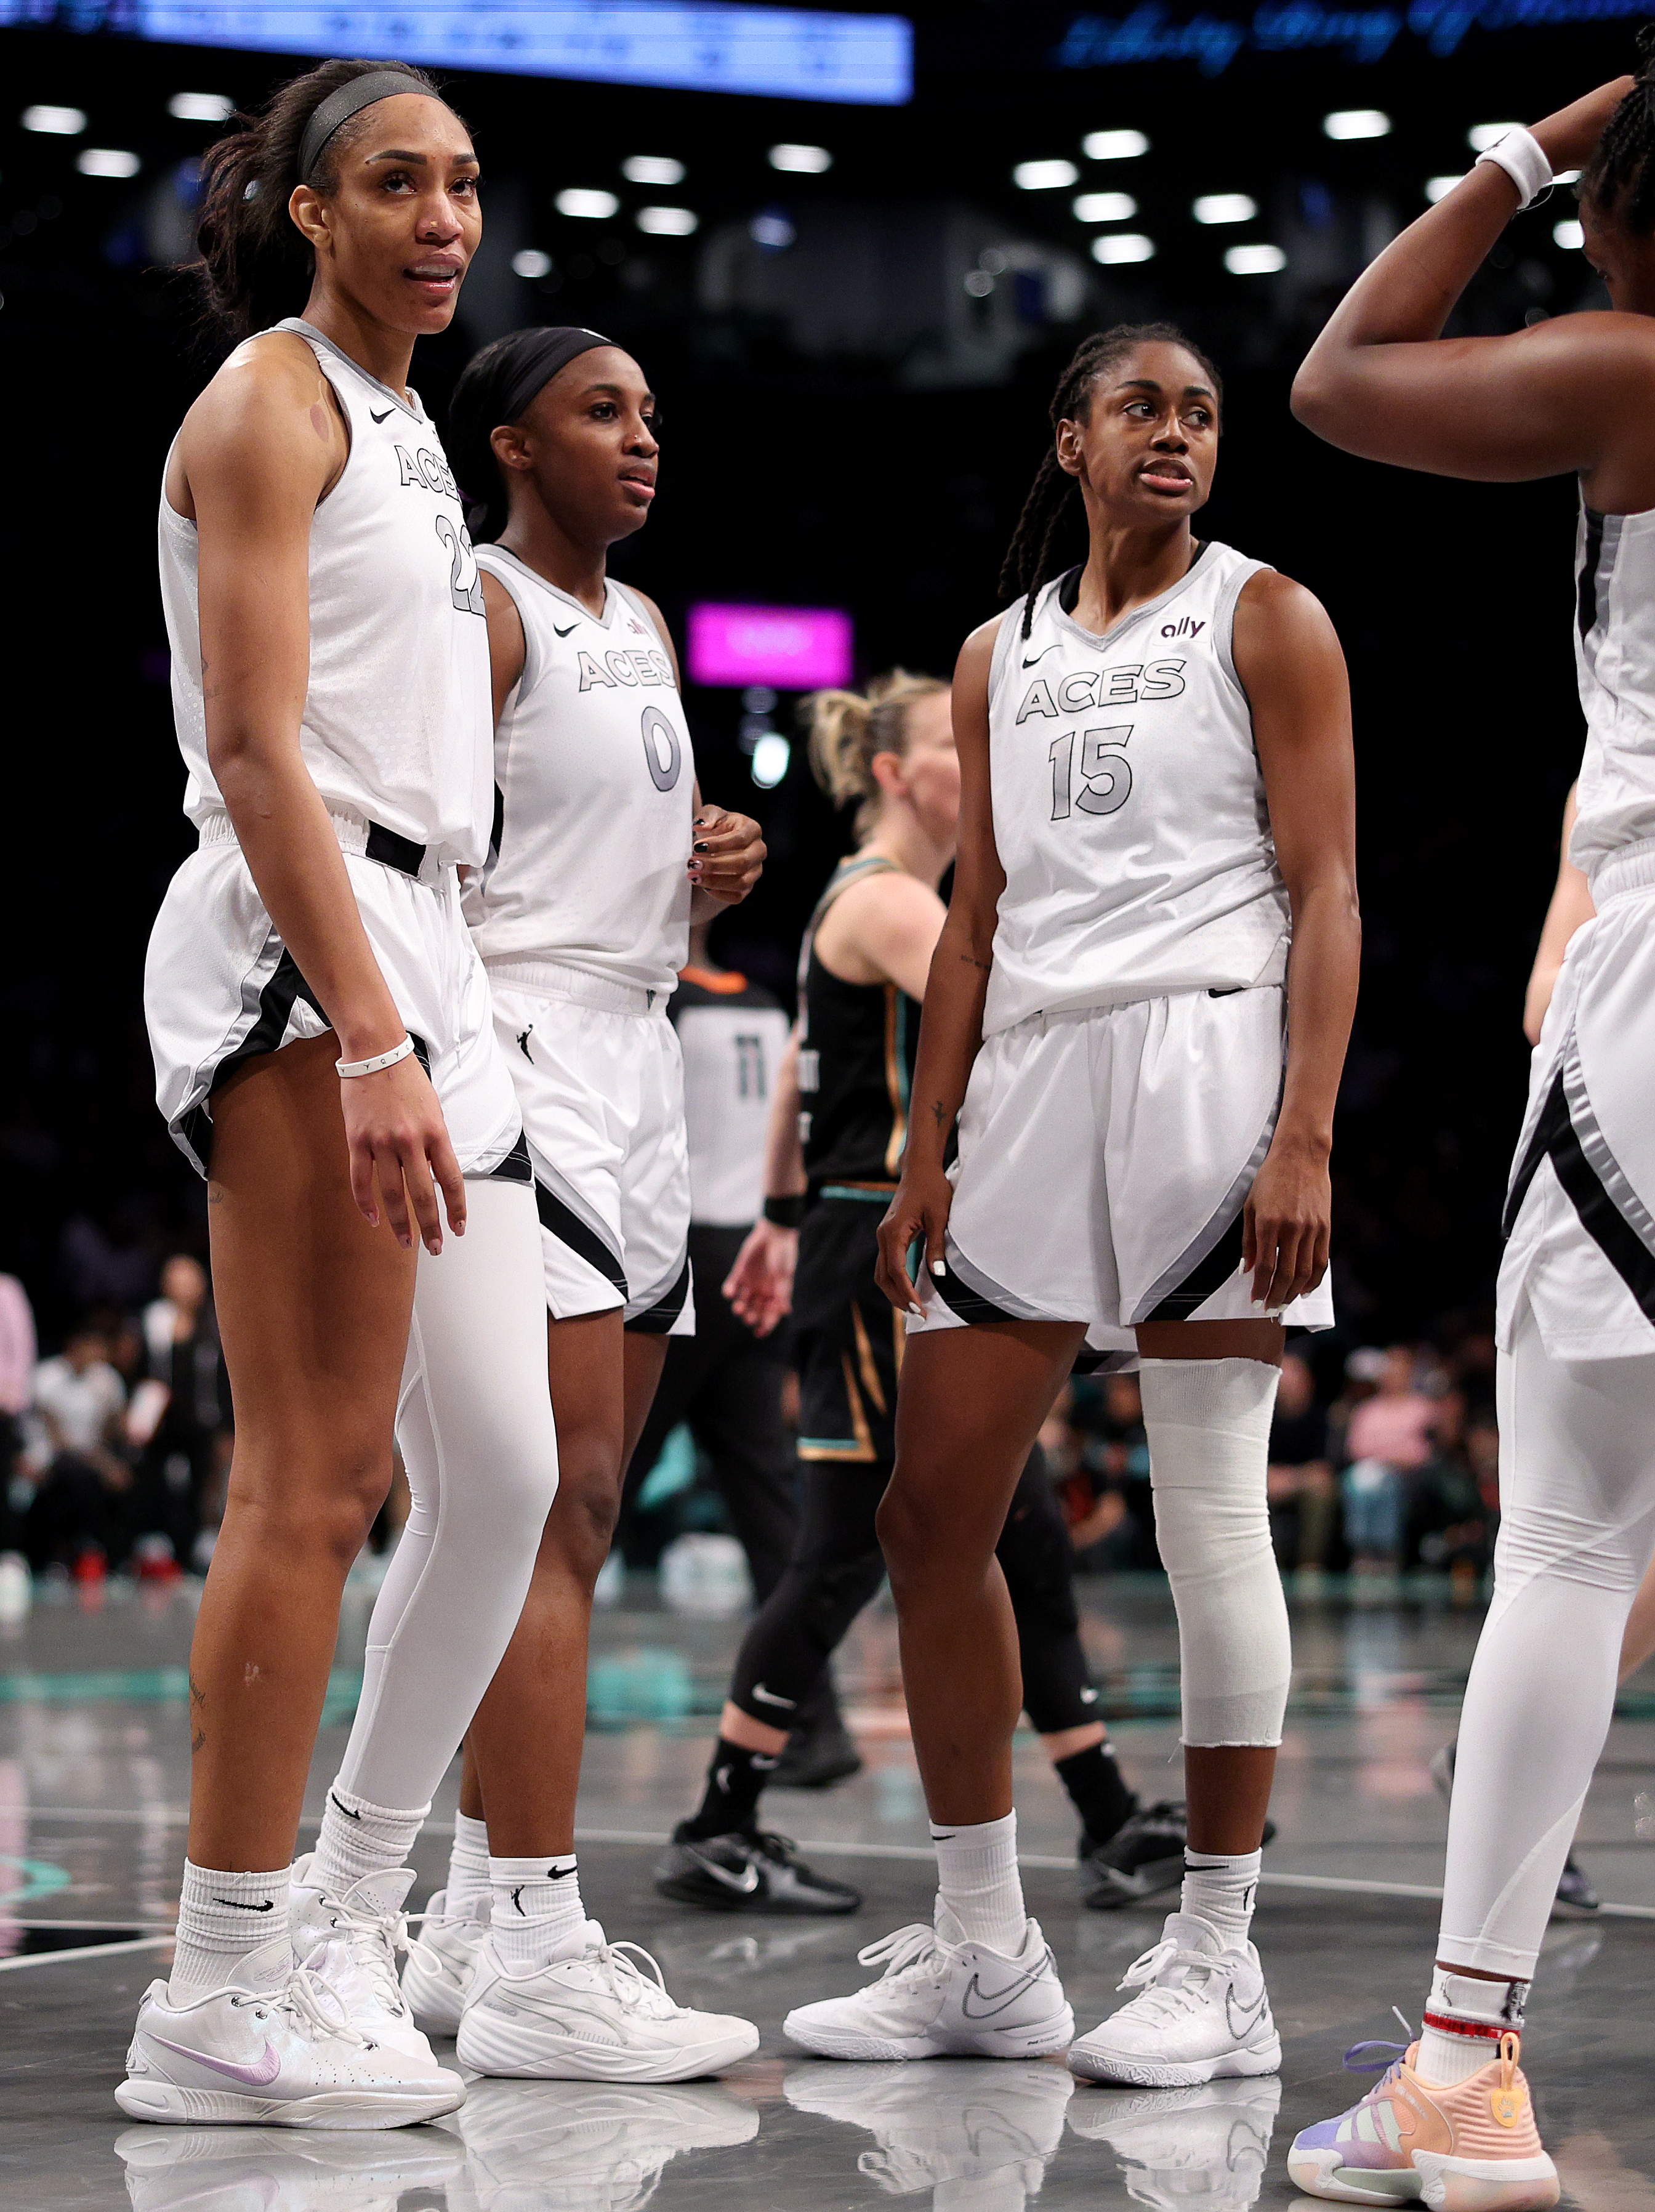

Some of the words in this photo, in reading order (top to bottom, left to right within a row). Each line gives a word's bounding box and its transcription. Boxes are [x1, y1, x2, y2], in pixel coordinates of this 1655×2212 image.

[394, 445, 461, 502] ACE
[1160, 616, 1206, 639] ally
[579, 650, 677, 693] ACES
[1016, 658, 1187, 725] ACES
[641, 706, 682, 792] 0
[1049, 725, 1134, 821] 15
[735, 1035, 765, 1097] 11
